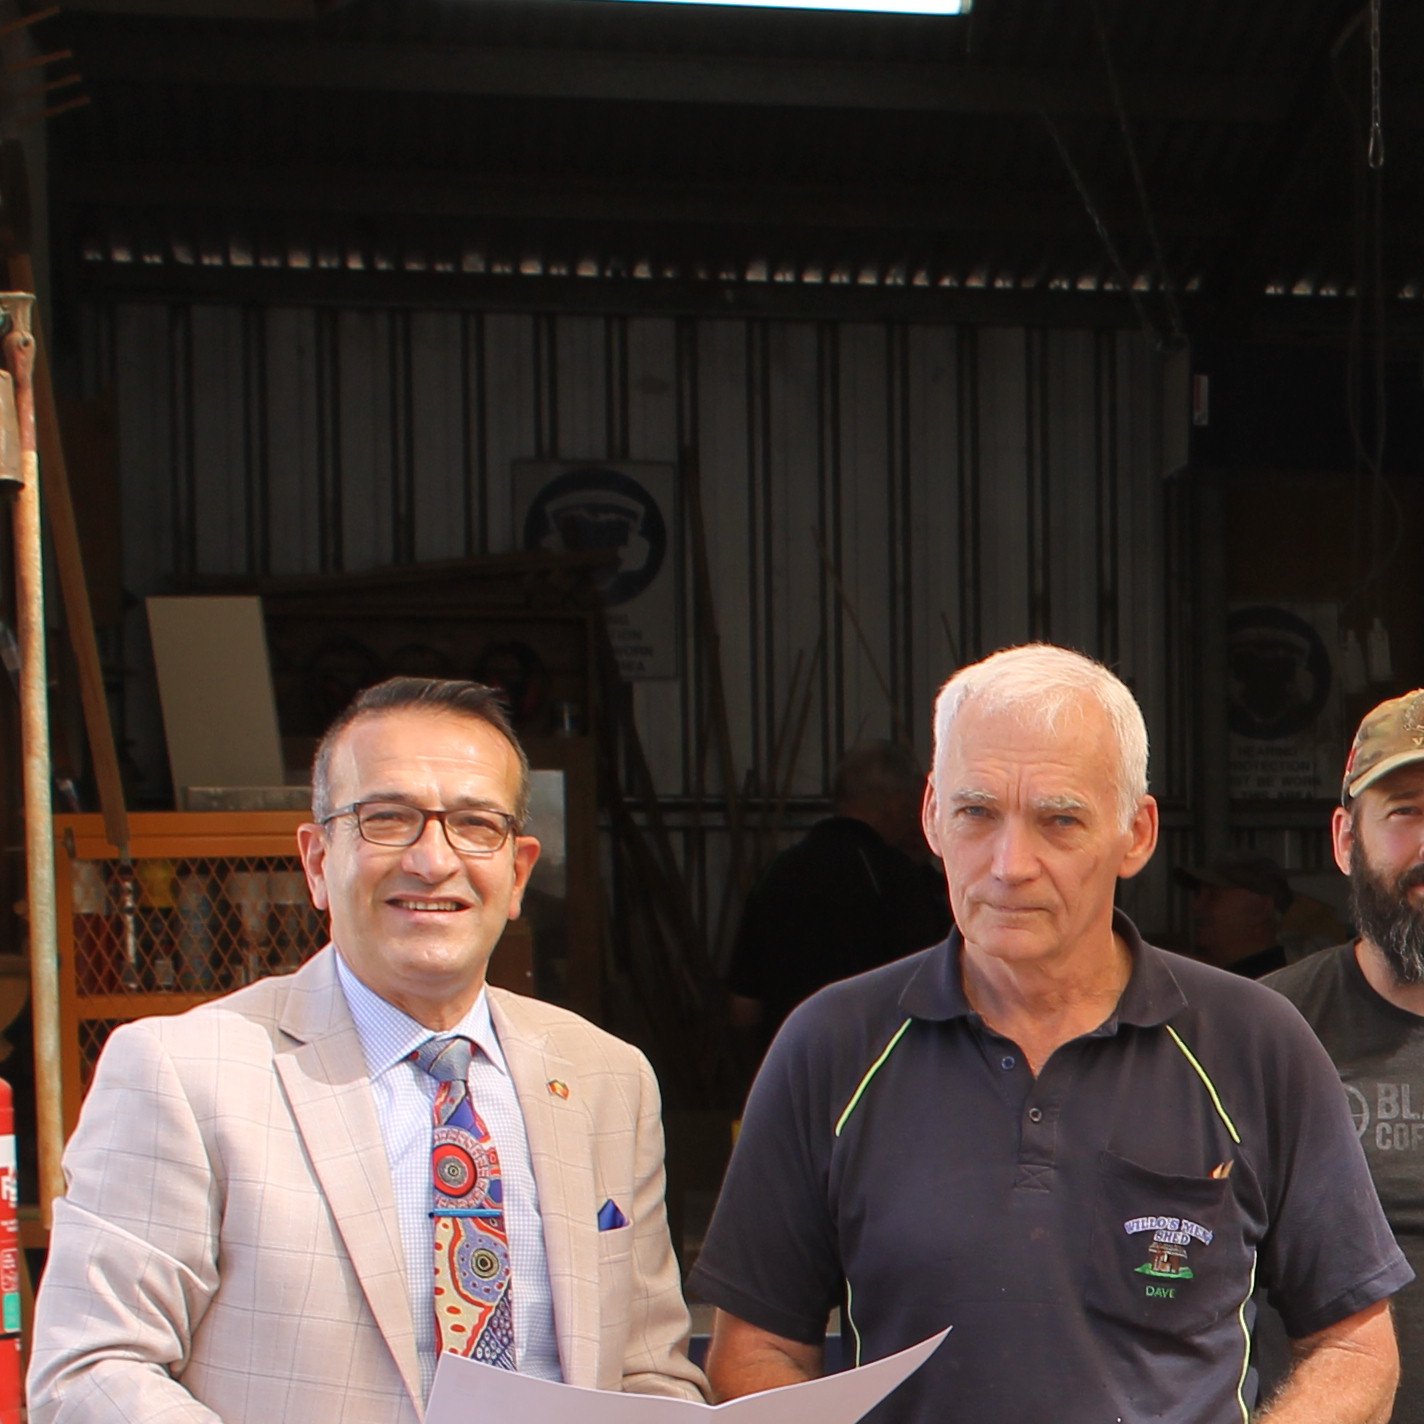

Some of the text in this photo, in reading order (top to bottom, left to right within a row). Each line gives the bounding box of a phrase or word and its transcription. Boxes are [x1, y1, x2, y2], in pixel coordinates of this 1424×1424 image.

[1229, 760, 1311, 772] ROTECTION
[1153, 1229, 1191, 1246] SHED
[1145, 1285, 1177, 1299] DAVE
